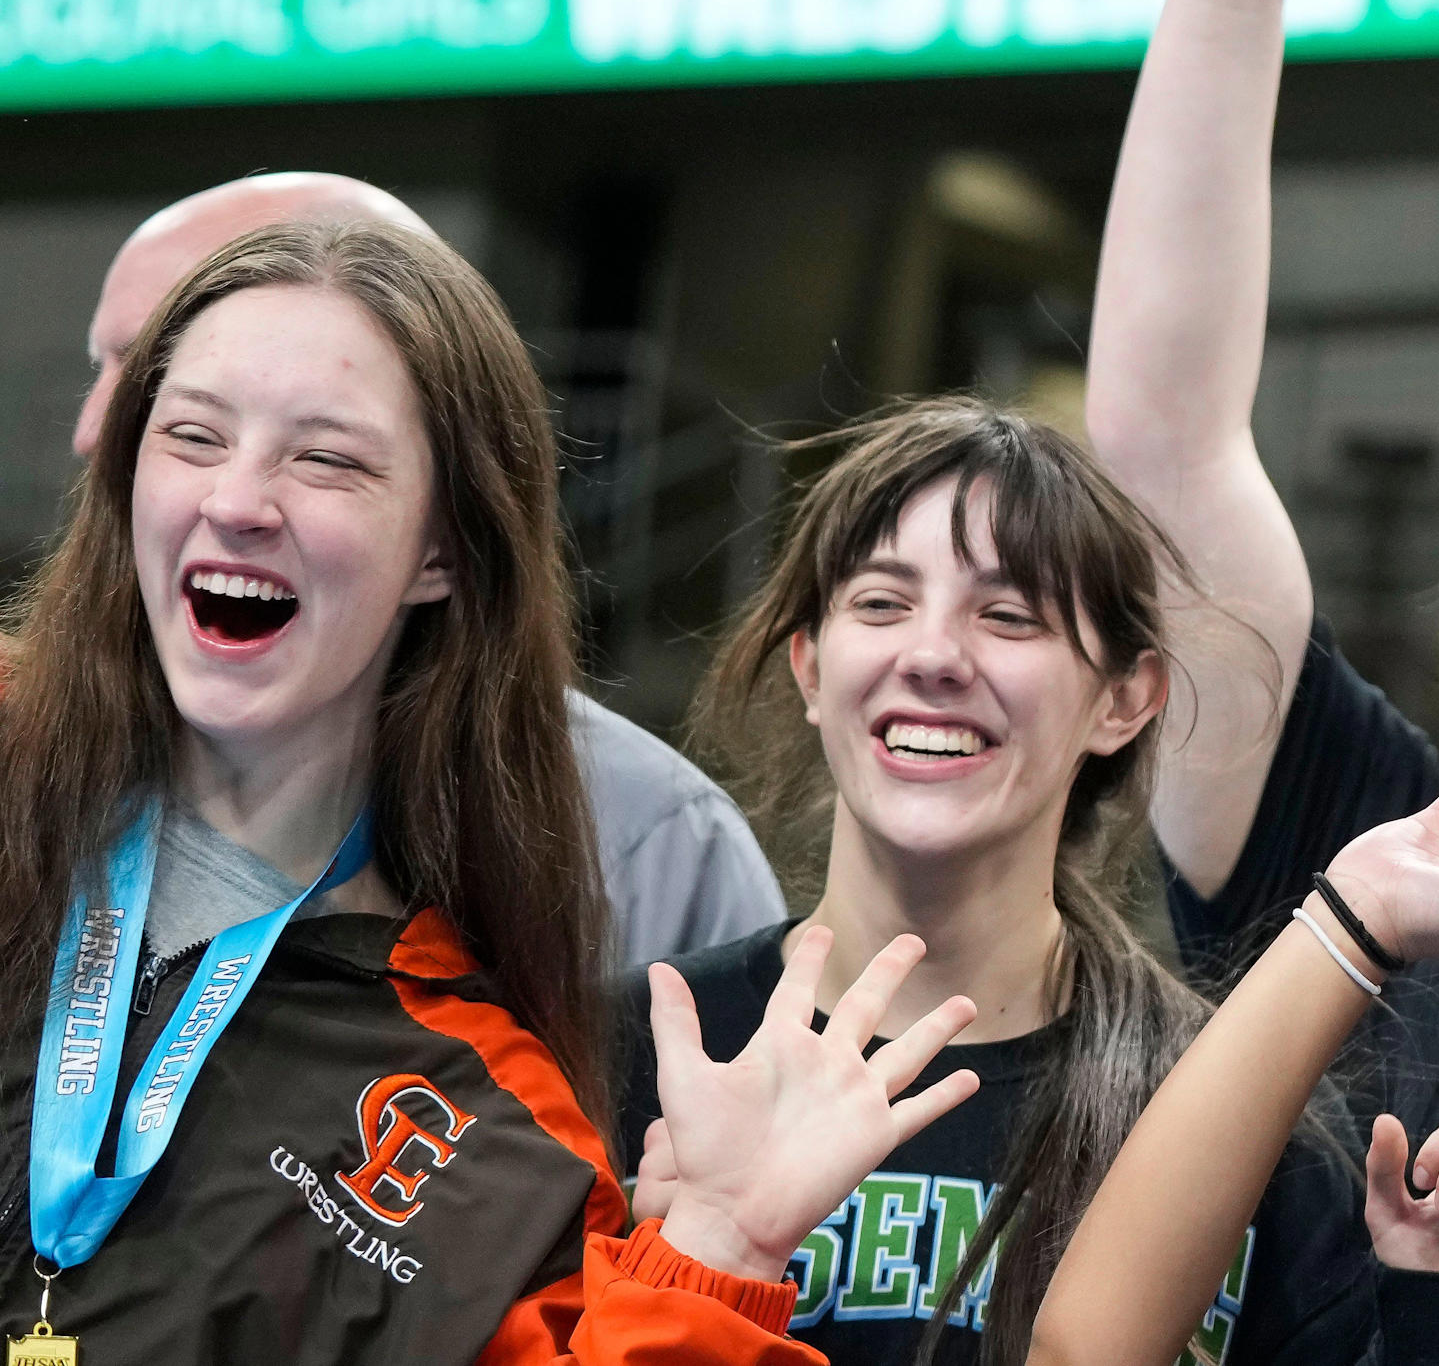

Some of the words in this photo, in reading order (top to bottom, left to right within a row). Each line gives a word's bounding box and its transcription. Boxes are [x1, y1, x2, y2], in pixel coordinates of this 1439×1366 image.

[57, 907, 126, 1096] WRESTLING
[136, 955, 252, 1134] WRESTLING
[270, 1146, 424, 1284] WRESTLING
